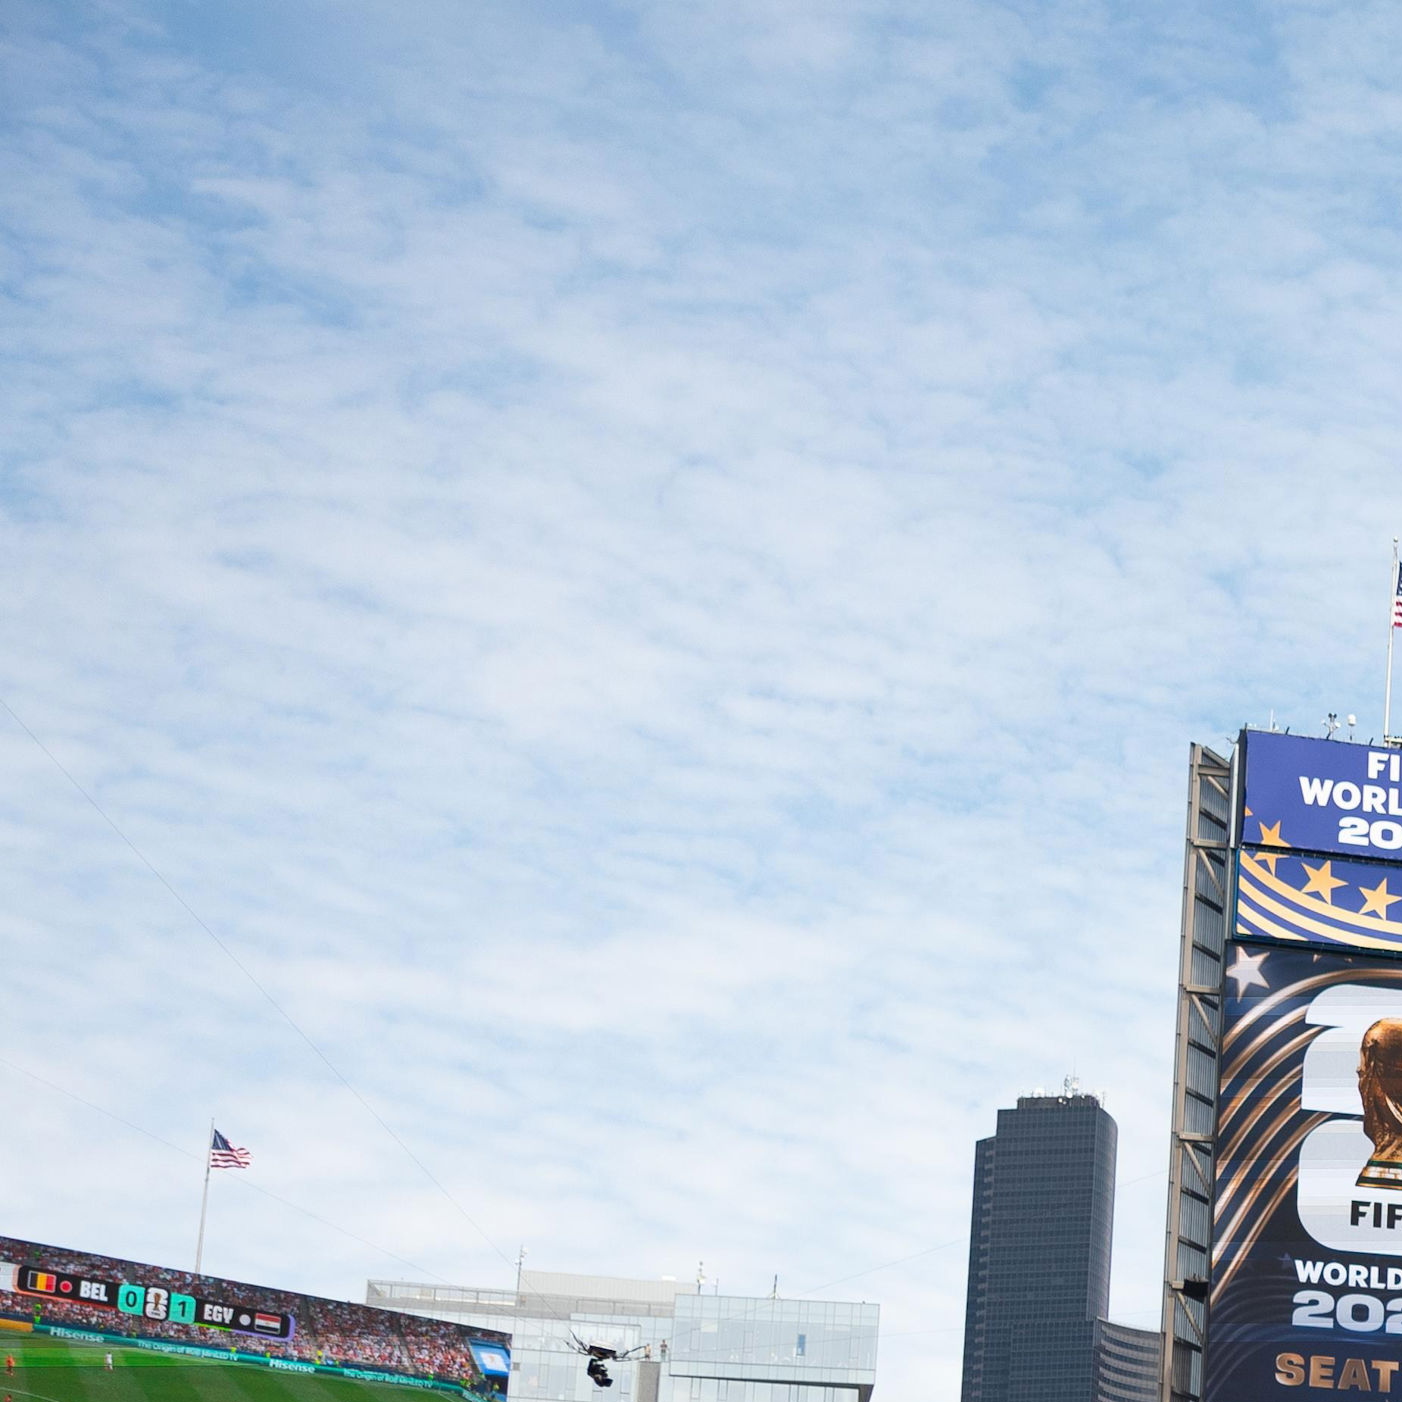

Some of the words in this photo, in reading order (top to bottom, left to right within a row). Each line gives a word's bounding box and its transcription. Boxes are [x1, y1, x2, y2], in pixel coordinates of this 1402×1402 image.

[79, 1280, 109, 1302] BEL
[50, 1326, 104, 1344] Hisense
[269, 1358, 315, 1374] Hisense
